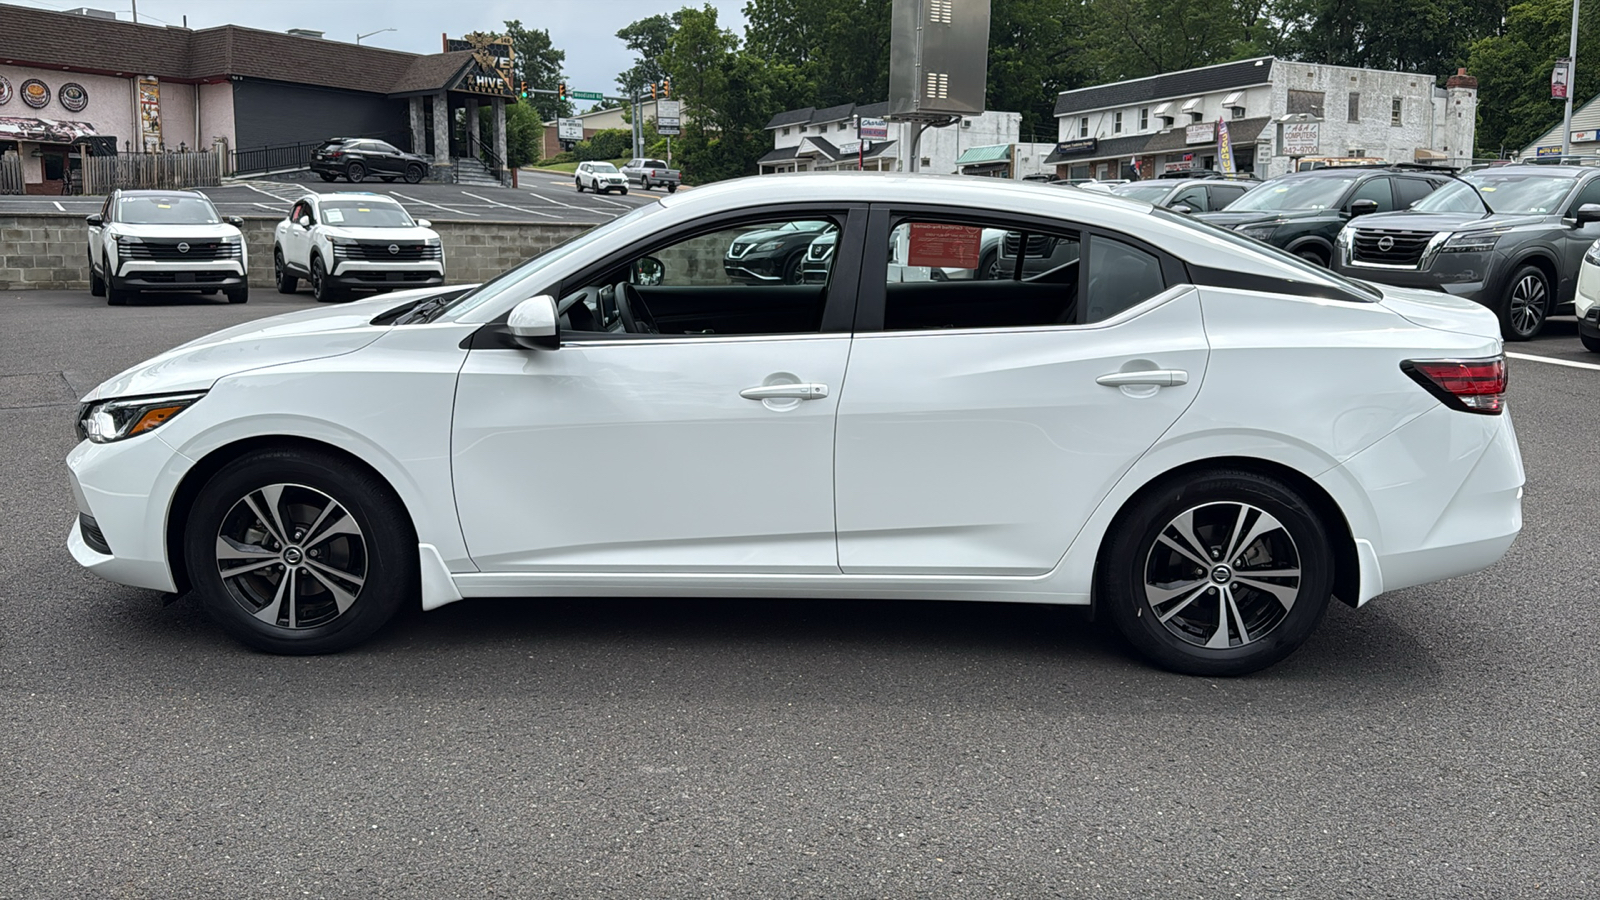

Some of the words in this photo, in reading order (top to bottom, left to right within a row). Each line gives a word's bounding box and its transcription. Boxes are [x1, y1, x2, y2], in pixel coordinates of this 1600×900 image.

[477, 75, 504, 89] HIVE
[469, 85, 504, 95] LOUNGE
[1283, 146, 1319, 154] 942-9700
